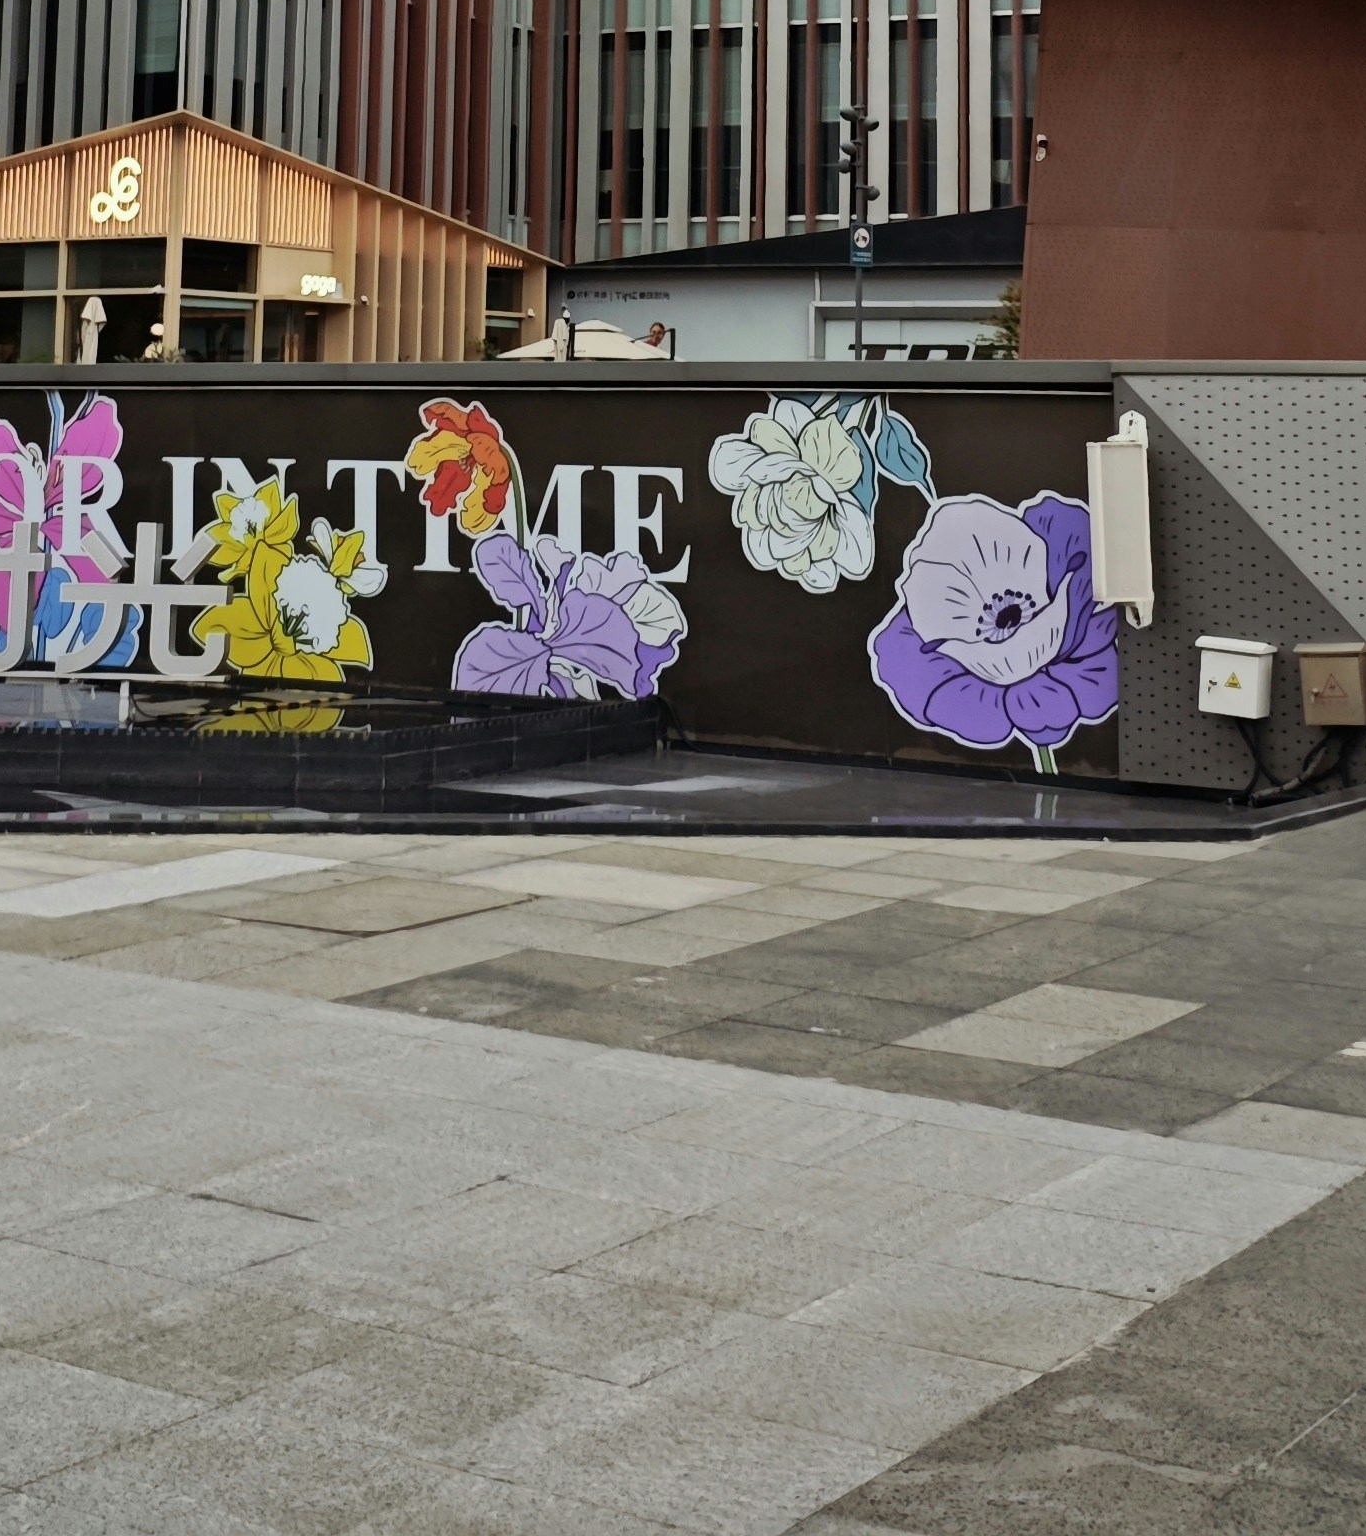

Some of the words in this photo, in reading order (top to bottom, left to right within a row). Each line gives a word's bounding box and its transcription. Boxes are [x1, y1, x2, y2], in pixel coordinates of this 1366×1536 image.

[301, 274, 337, 297] gaga
[162, 456, 297, 560] IN
[326, 459, 692, 583] TIME
